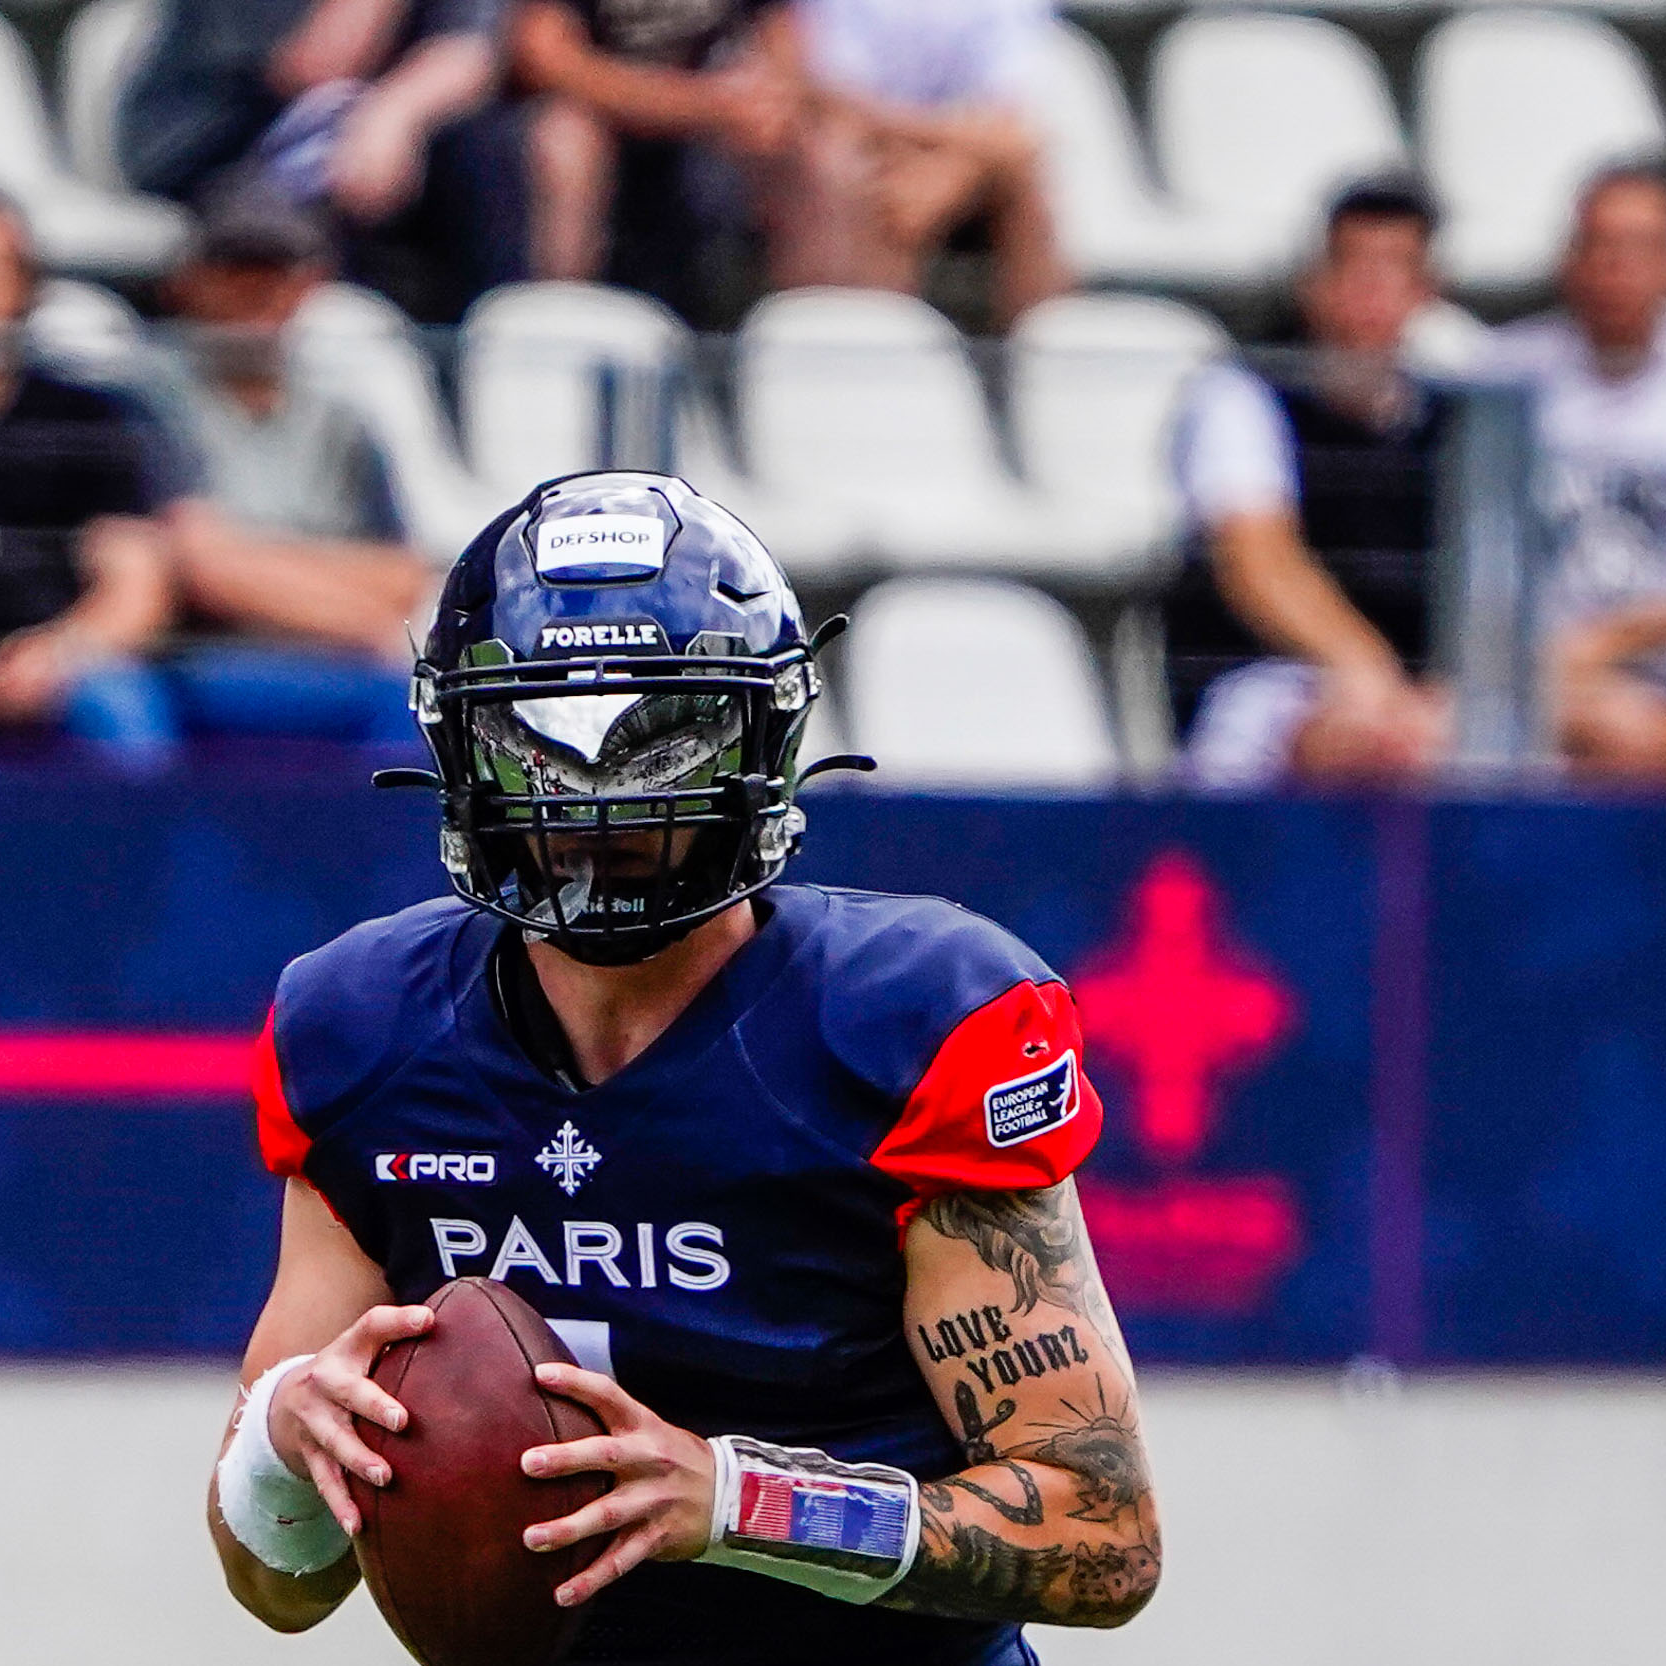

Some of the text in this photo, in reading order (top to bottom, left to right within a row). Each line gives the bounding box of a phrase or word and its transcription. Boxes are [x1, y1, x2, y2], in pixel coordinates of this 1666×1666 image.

[550, 531, 650, 549] DEFSHOP
[541, 624, 657, 649] FORELLE
[992, 1081, 1049, 1110] EUROPEAN
[993, 1100, 1035, 1123] LEAGUE
[995, 1108, 1048, 1136] FOOTBALL
[429, 1214, 731, 1291] PARIS
[918, 1305, 1012, 1363] LOVE
[967, 1325, 1089, 1394] YOURZ
